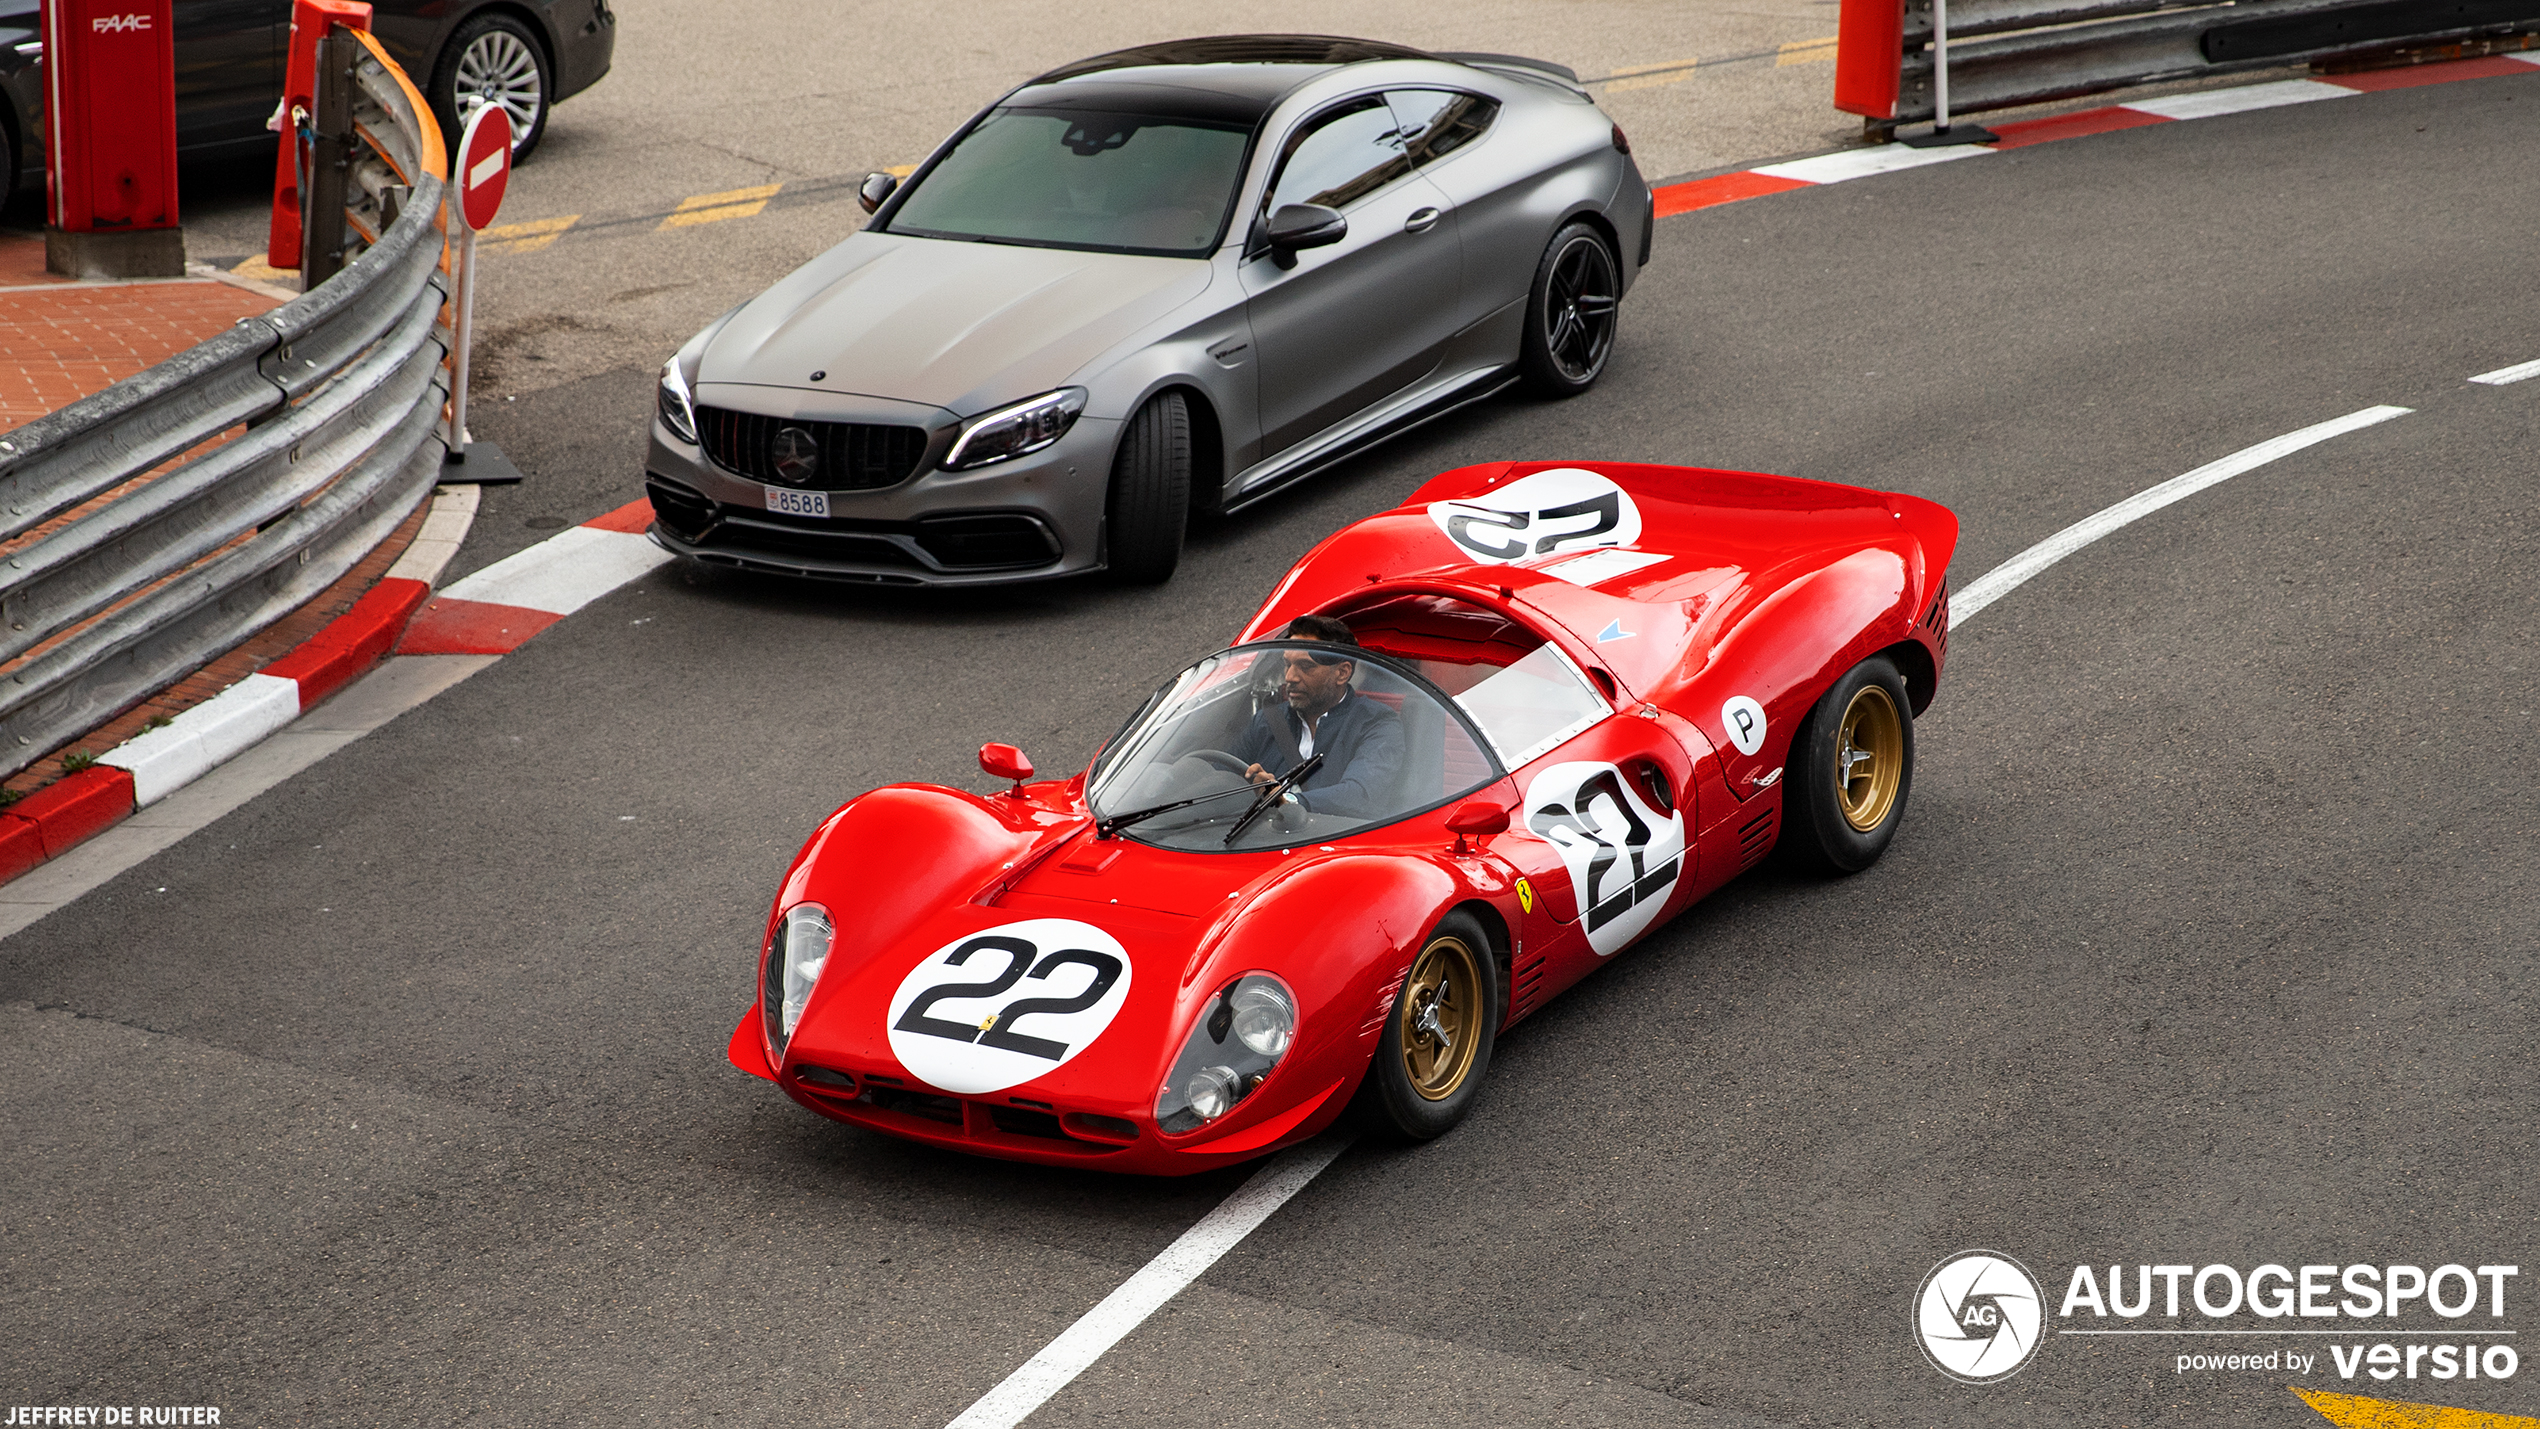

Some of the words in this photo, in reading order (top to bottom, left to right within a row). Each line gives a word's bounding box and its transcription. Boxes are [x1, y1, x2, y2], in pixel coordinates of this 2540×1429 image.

[92, 13, 153, 34] FAAC
[780, 492, 825, 514] 8588
[1732, 707, 1754, 744] P
[1529, 769, 1679, 936] 22
[893, 935, 1123, 1061] 22
